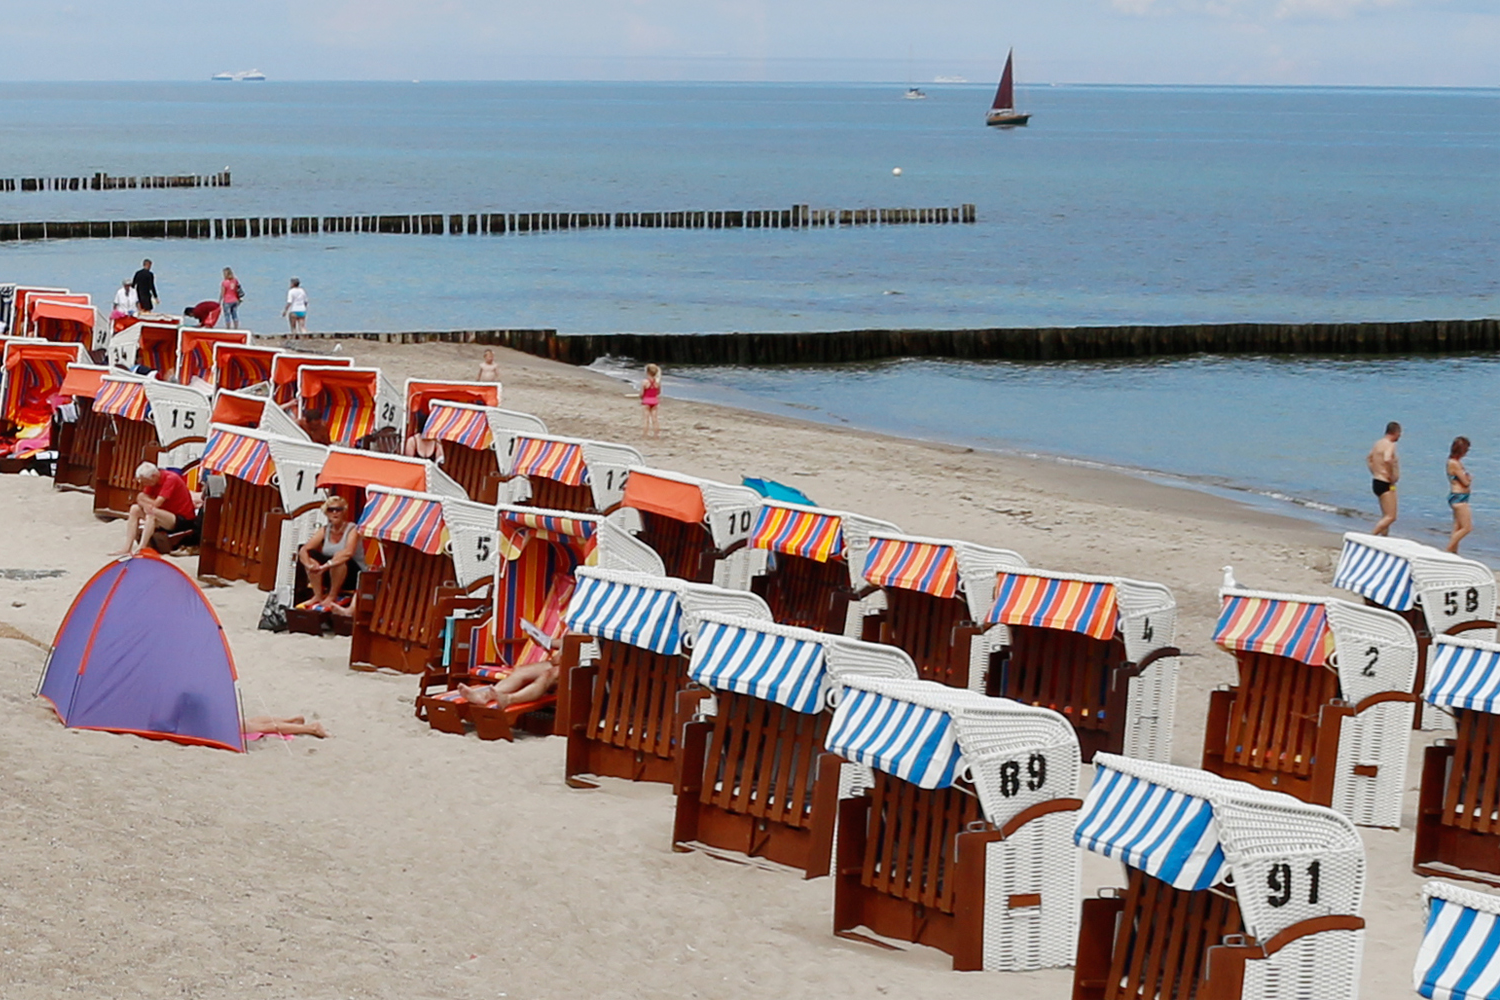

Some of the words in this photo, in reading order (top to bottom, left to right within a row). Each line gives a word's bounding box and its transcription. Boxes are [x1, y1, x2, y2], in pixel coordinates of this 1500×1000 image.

[172, 409, 196, 429] 15
[382, 402, 395, 422] 26
[607, 469, 629, 491] 12
[729, 511, 751, 535] 10
[476, 536, 491, 561] 5
[1141, 617, 1153, 643] 4
[1362, 646, 1379, 677] 2
[1000, 753, 1046, 798] 89
[1266, 861, 1320, 908] 91
